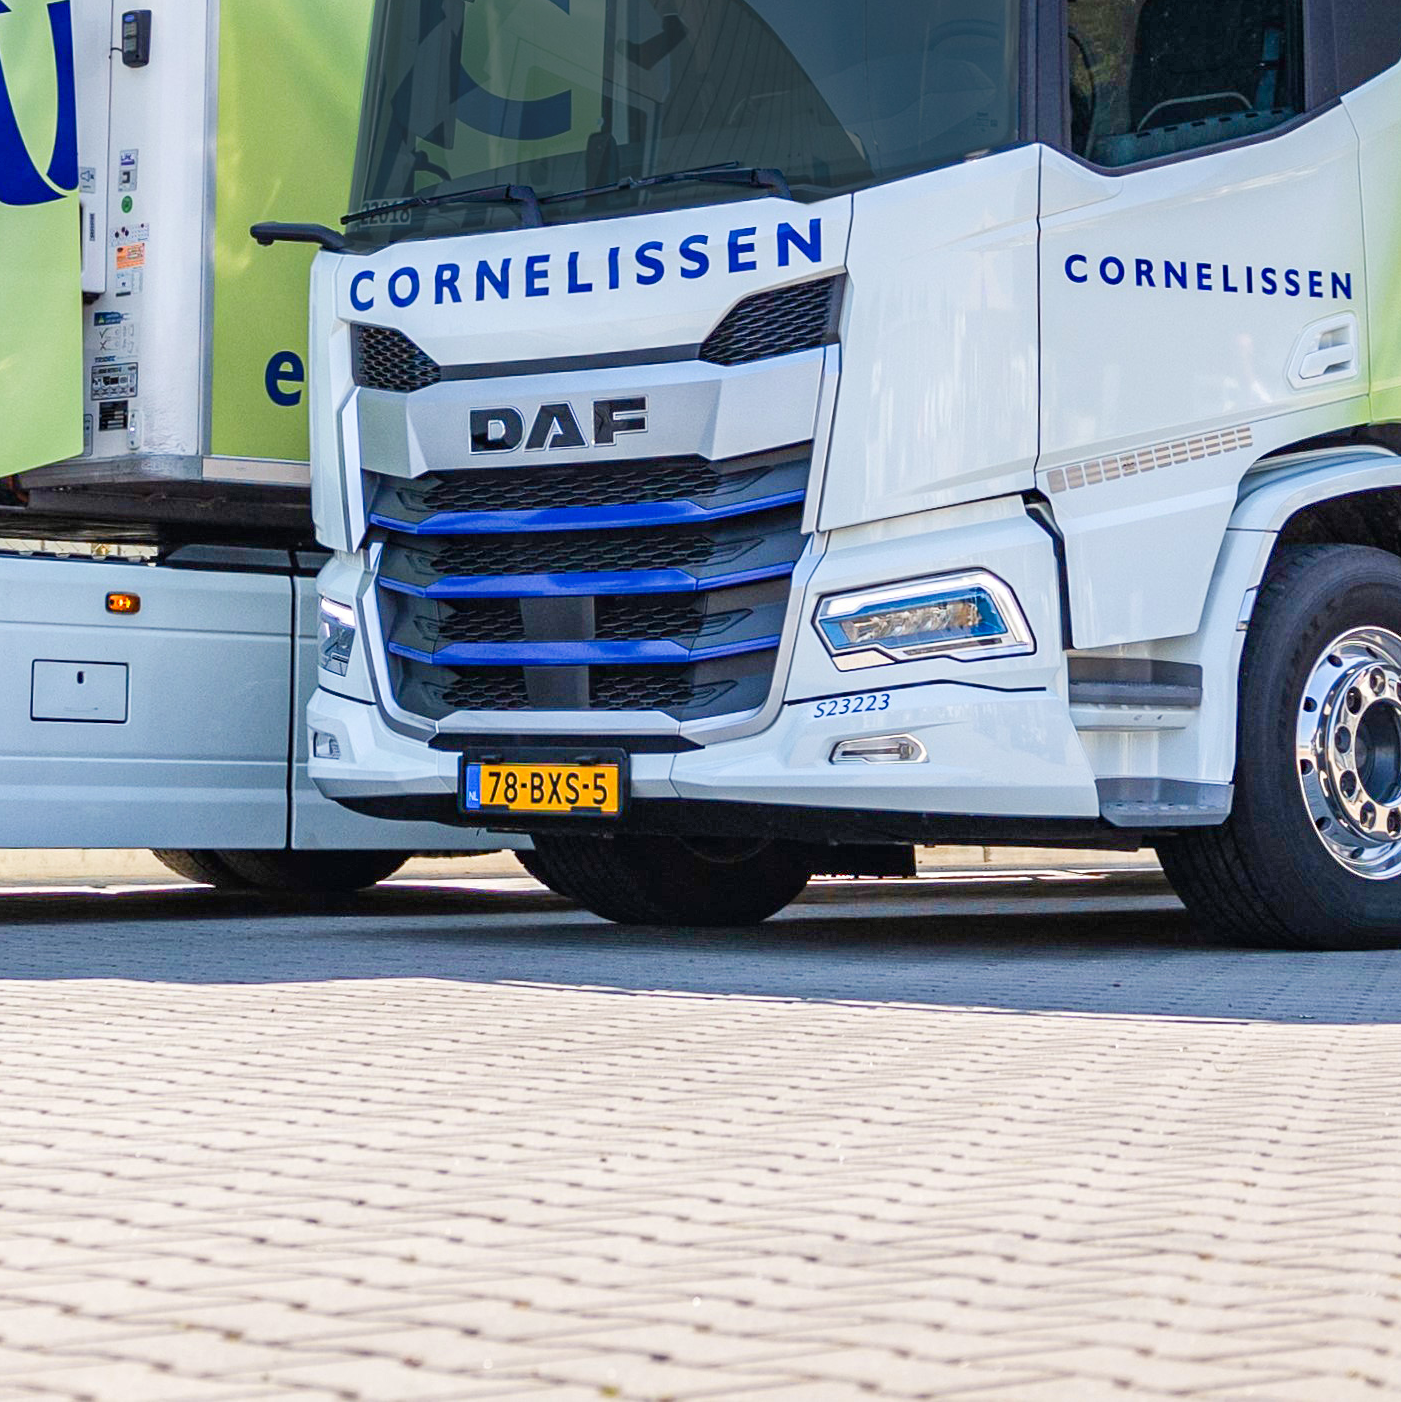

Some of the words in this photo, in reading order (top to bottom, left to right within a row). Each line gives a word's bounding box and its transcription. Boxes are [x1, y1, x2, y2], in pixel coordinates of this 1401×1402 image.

[350, 218, 822, 311] CORNELISSEN
[1064, 253, 1352, 300] CORNELISSEN
[468, 394, 649, 456] DAF
[813, 693, 891, 719] S23223
[488, 771, 608, 805] 78-BXS-5
